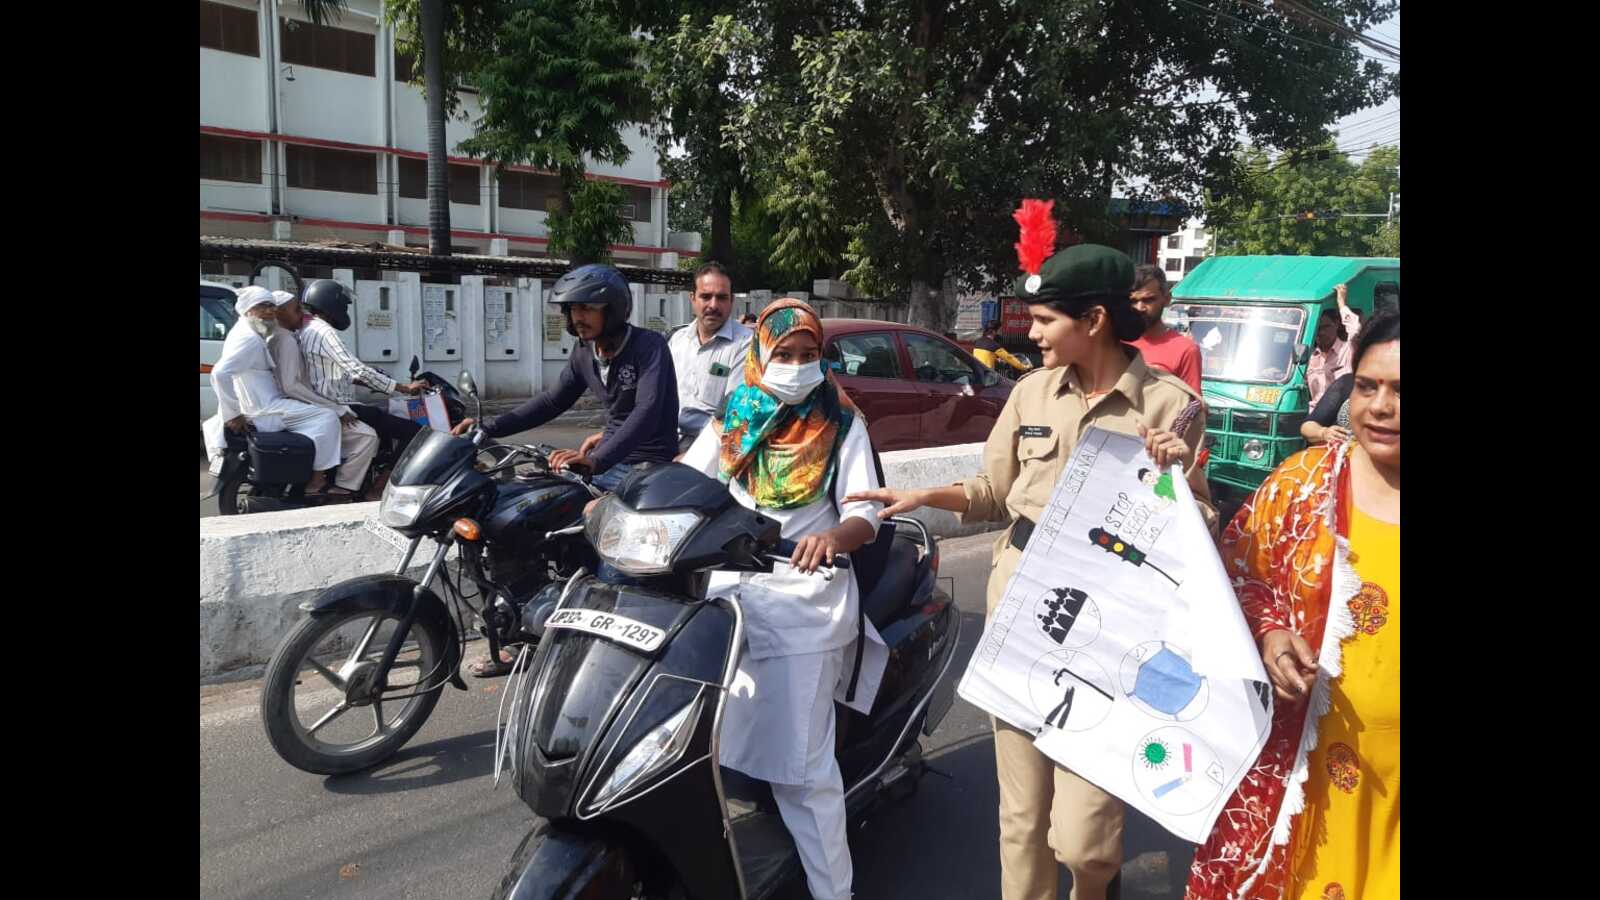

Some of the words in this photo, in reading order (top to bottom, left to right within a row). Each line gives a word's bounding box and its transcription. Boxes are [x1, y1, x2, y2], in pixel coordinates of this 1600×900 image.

[1105, 492, 1132, 528] STOP
[590, 615, 615, 630] GR
[620, 623, 659, 645] 1297
